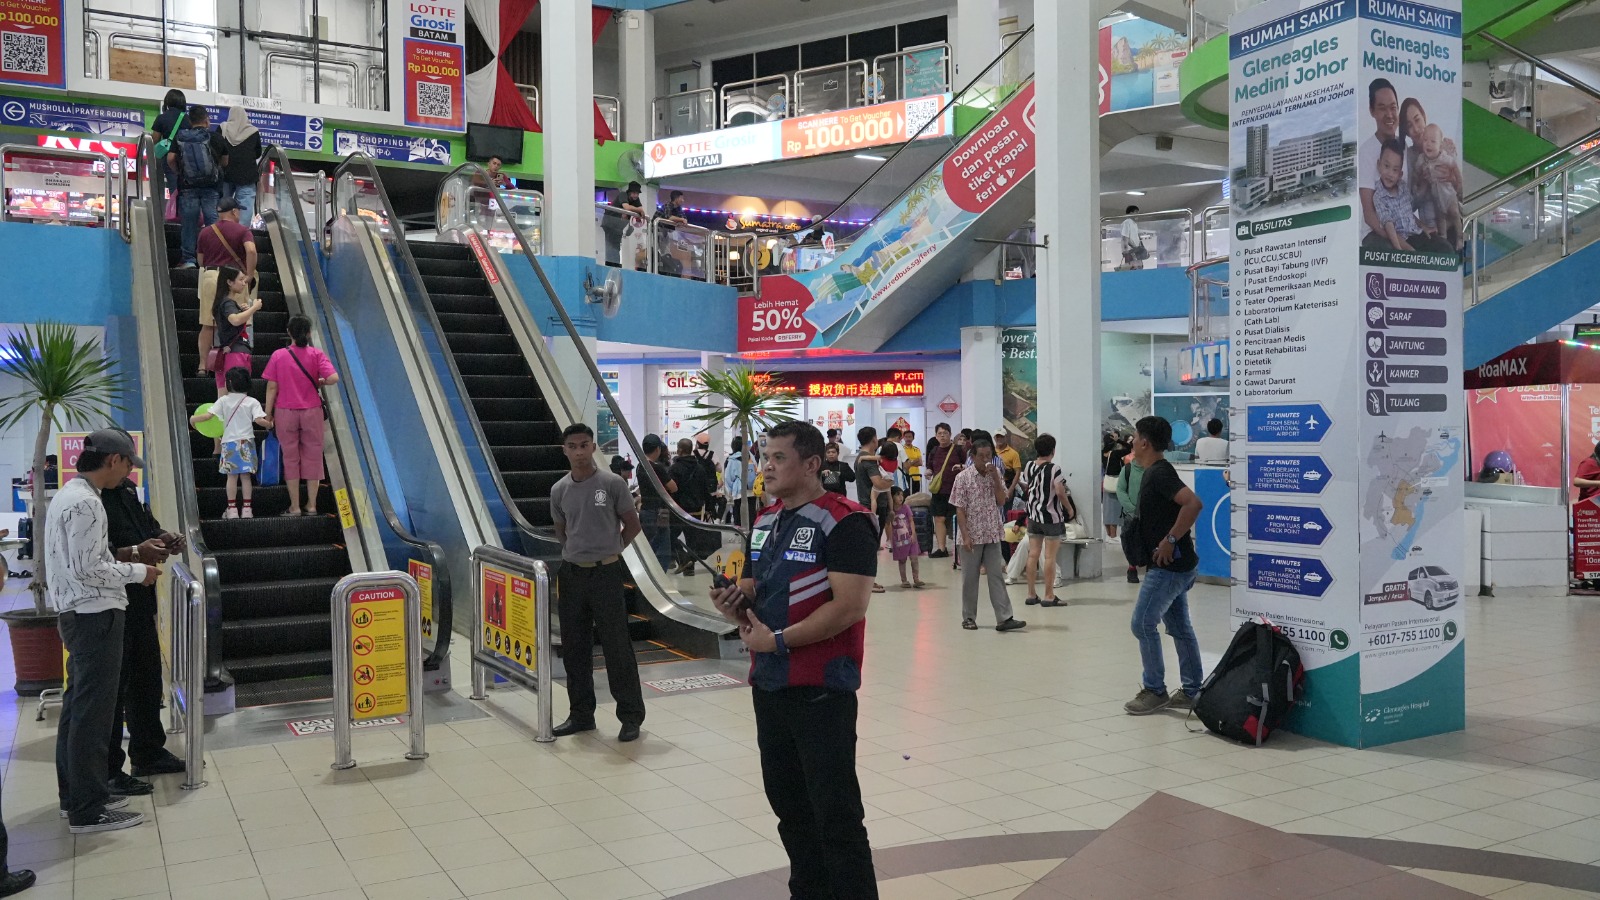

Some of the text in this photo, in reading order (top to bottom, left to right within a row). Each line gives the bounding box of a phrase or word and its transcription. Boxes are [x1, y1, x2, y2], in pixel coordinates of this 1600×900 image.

[21, 3, 52, 12] Voucher
[410, 3, 456, 18] LOTTE
[8, 11, 59, 27] 100.000
[1368, 0, 1453, 30] RUMAH SAKIT
[410, 14, 456, 31] Grosir
[1241, 1, 1345, 50] RUMAH SAKIT
[418, 29, 449, 40] BATAM
[1370, 28, 1450, 60] Gleneagles
[416, 48, 451, 58] SCAN HERE
[1242, 36, 1339, 78] Gleneagles
[408, 62, 460, 77] Rp 100.000
[1363, 50, 1457, 83] Medini Johor
[1234, 57, 1349, 103] Medini Johor
[1241, 82, 1345, 117] PENYEDIA LAYANAN KESEHATAN
[29, 103, 129, 119] MUSHOLLA PRAYER ROOM
[1231, 87, 1355, 128] INTERNASIONAL TERNAMA DI JOHOR
[797, 111, 892, 130] SCAN HERE To Get Voucher
[360, 136, 404, 147] SHOPPING
[786, 117, 894, 153] Rp 100.000
[952, 116, 1010, 168] Download
[669, 131, 758, 156] LOTTE Grosir
[686, 153, 720, 168] BATAM
[961, 129, 1019, 180] dan pesan
[968, 140, 1028, 192] tiket kapal
[975, 182, 997, 204] feri
[739, 216, 783, 230] Sumatra
[1255, 218, 1292, 232] FASILITAS
[1244, 235, 1327, 256] Pusat Rawatan Intensif
[1364, 251, 1456, 267] PUSAT KECEMERLANGAN
[871, 243, 937, 301] www.redbus.sg/ferry
[1244, 257, 1328, 276] Pusat Bayi Tabung (IVF)
[1248, 271, 1307, 285] Pusat Endoskopi
[1244, 278, 1336, 296] Pusat Pemeriksaan Medis
[1389, 283, 1441, 295] IBU DAN ANAK
[754, 299, 799, 309] Lebih Hemat
[1244, 293, 1296, 306] Teater Operasi
[1244, 299, 1338, 316] Laboratorium Kateterisasi
[751, 307, 802, 331] 50%
[1244, 316, 1280, 327] (Cath Lab)
[1389, 312, 1413, 321] SARAF
[1244, 325, 1290, 336] Pusat Dialisis
[1002, 334, 1030, 344] over
[1244, 335, 1306, 346] Pencitraan Medis
[1389, 341, 1425, 350] JANTUNG
[1009, 347, 1037, 359] Best.
[1244, 345, 1307, 356] Pusat Rehabilitasi
[1244, 358, 1272, 366] Dietetik
[1478, 357, 1527, 378] RoaMAX
[1244, 368, 1271, 376] Farmasi
[1389, 369, 1420, 378] KANKER
[1244, 377, 1296, 386] Gawat Darurat
[1244, 388, 1293, 396] Laboratorium
[1389, 398, 1420, 407] TULANG
[64, 439, 85, 451] HAT
[1275, 514, 1301, 522] MINUTES
[1275, 559, 1301, 567] MINUTES
[1258, 575, 1301, 585] INTERNATIONAL
[1384, 583, 1406, 592] GRATIS
[358, 591, 395, 601] CAUTION
[1235, 607, 1265, 617] Pelayanan
[1285, 613, 1325, 626] Internasional
[1364, 622, 1391, 631] Pelayanan
[1298, 628, 1326, 642] 1100
[1367, 627, 1440, 646] +6017-755 1100
